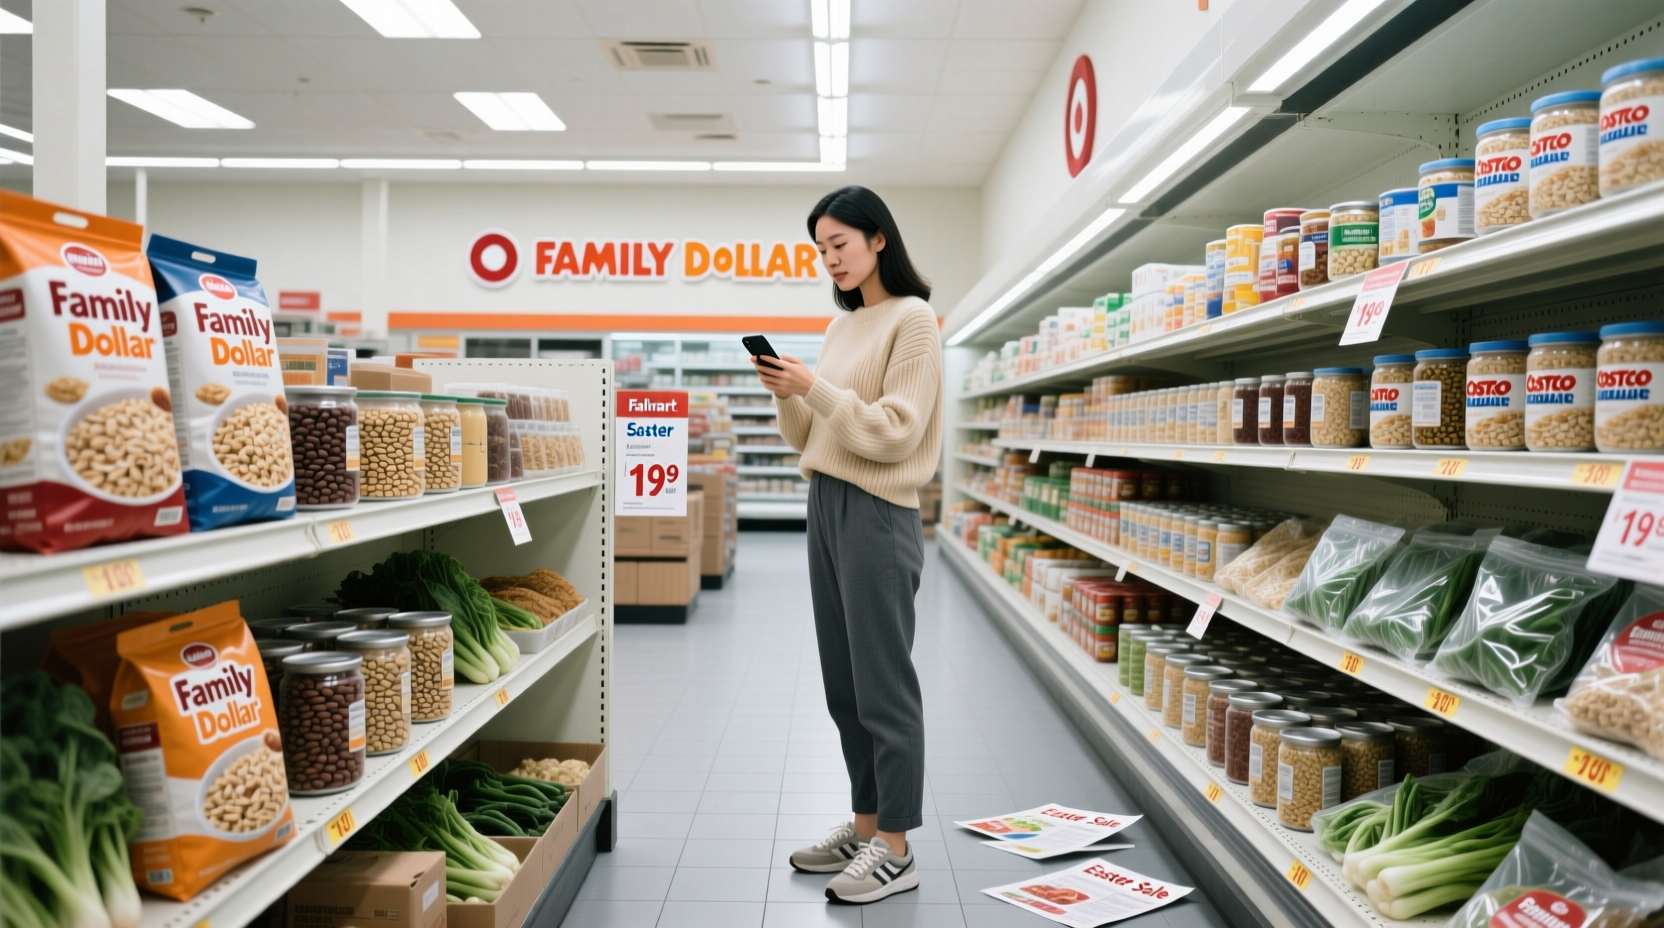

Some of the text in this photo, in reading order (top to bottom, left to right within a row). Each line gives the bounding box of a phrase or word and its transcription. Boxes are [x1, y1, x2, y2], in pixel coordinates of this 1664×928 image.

[535, 241, 674, 277] FAMILY
[49, 280, 152, 333] Family
[194, 303, 271, 345] Family
[69, 323, 155, 360] Dollar
[210, 337, 274, 368] Dollar
[174, 664, 252, 712] Family
[197, 700, 258, 740] Dollar
